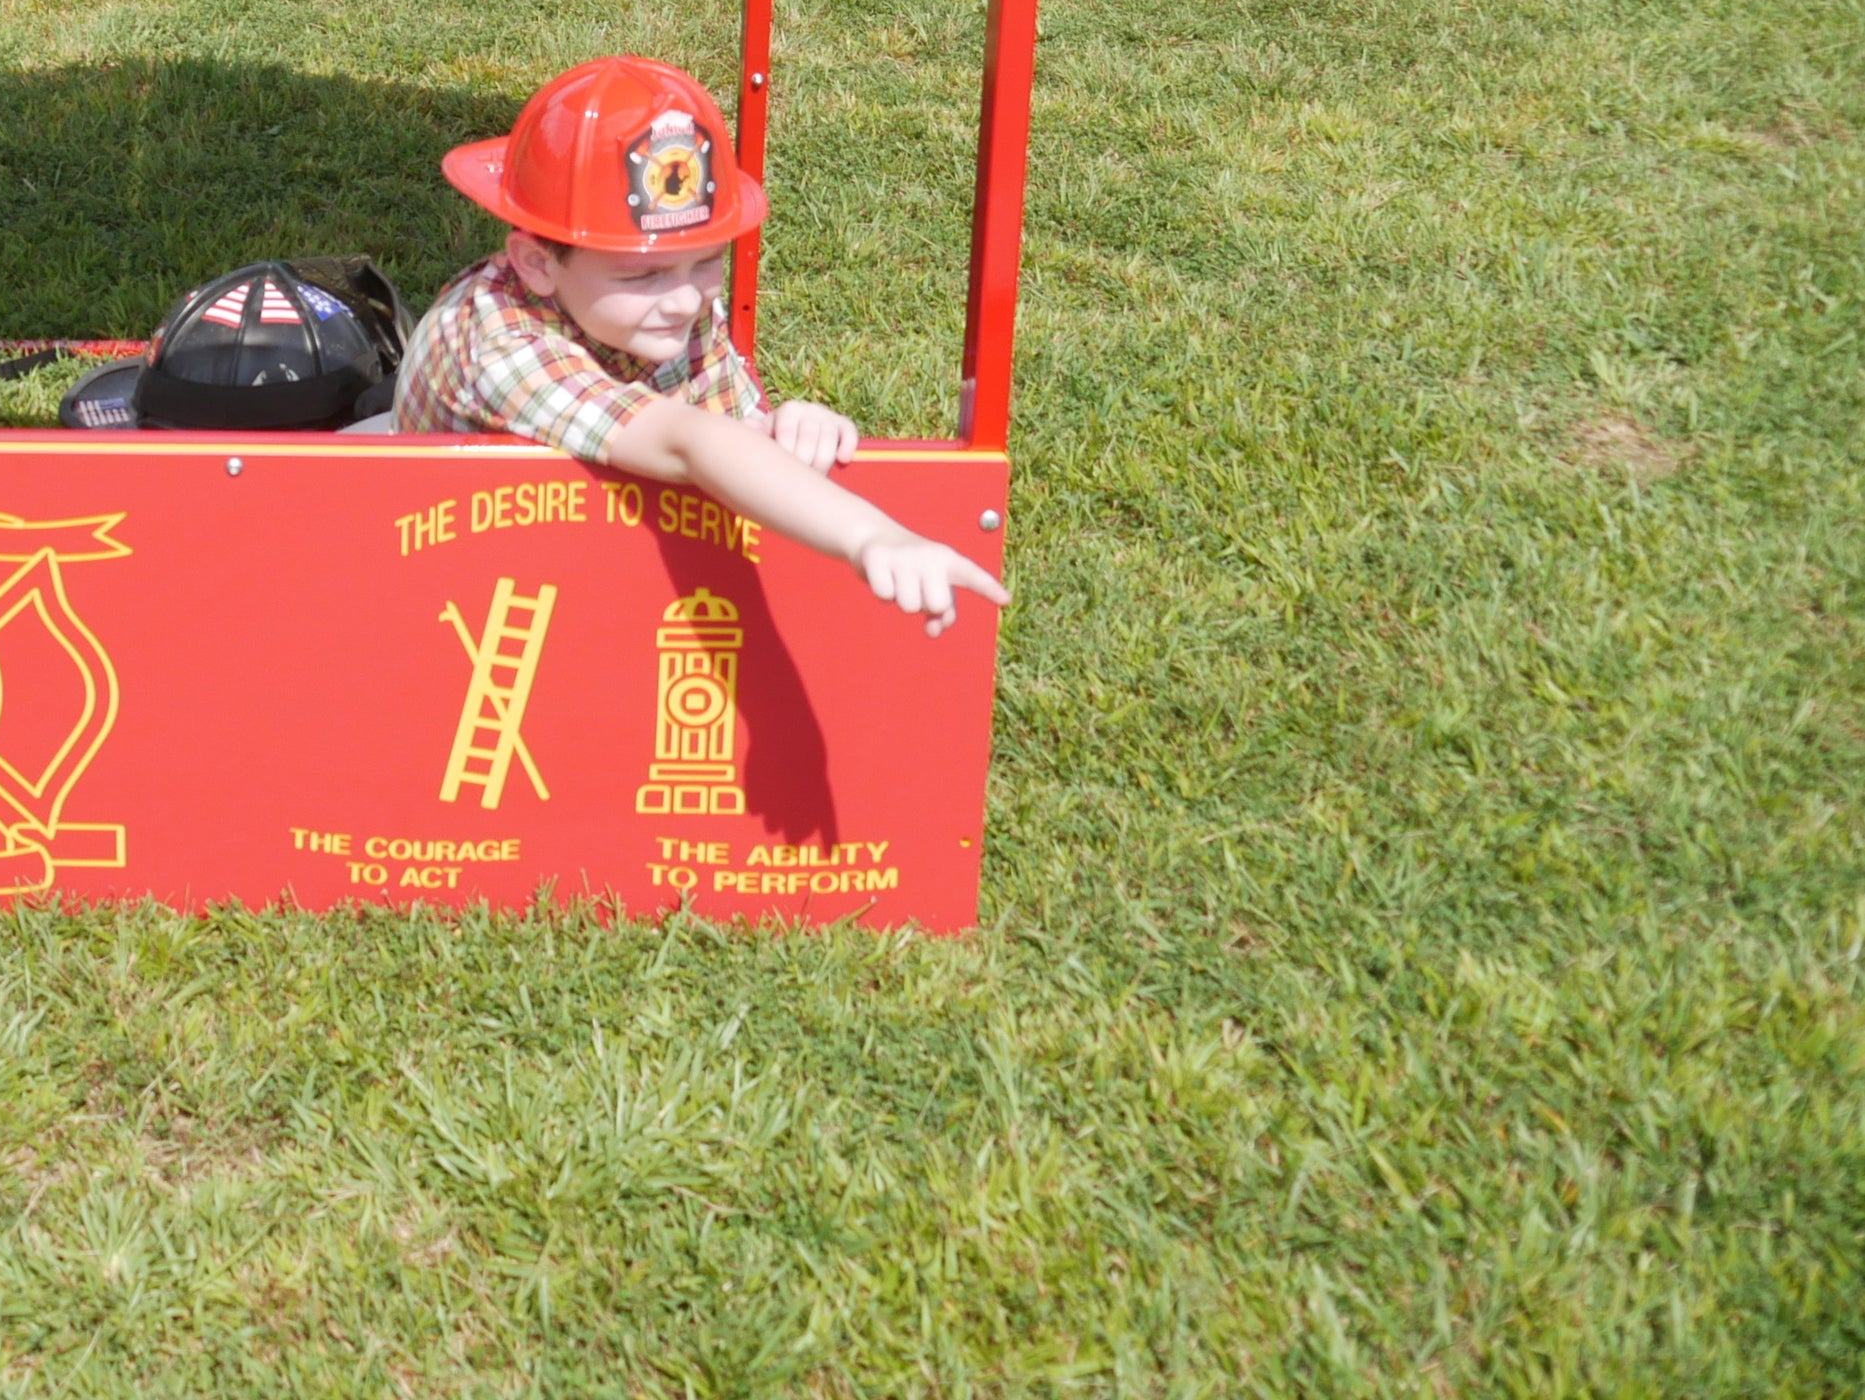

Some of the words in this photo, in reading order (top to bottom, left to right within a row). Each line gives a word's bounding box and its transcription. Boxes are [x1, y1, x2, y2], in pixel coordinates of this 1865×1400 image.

[394, 499, 457, 557] THE
[471, 481, 587, 533] DESIRE
[601, 481, 644, 527] TO
[658, 489, 762, 564] SERVE
[289, 827, 352, 855] THE
[364, 836, 521, 861] COURAGE
[655, 836, 730, 865] THE
[746, 840, 889, 867] ABILITY
[345, 861, 389, 885] TO
[399, 866, 463, 889] ACT
[645, 862, 698, 888] TO
[713, 867, 899, 894] PERFORM
